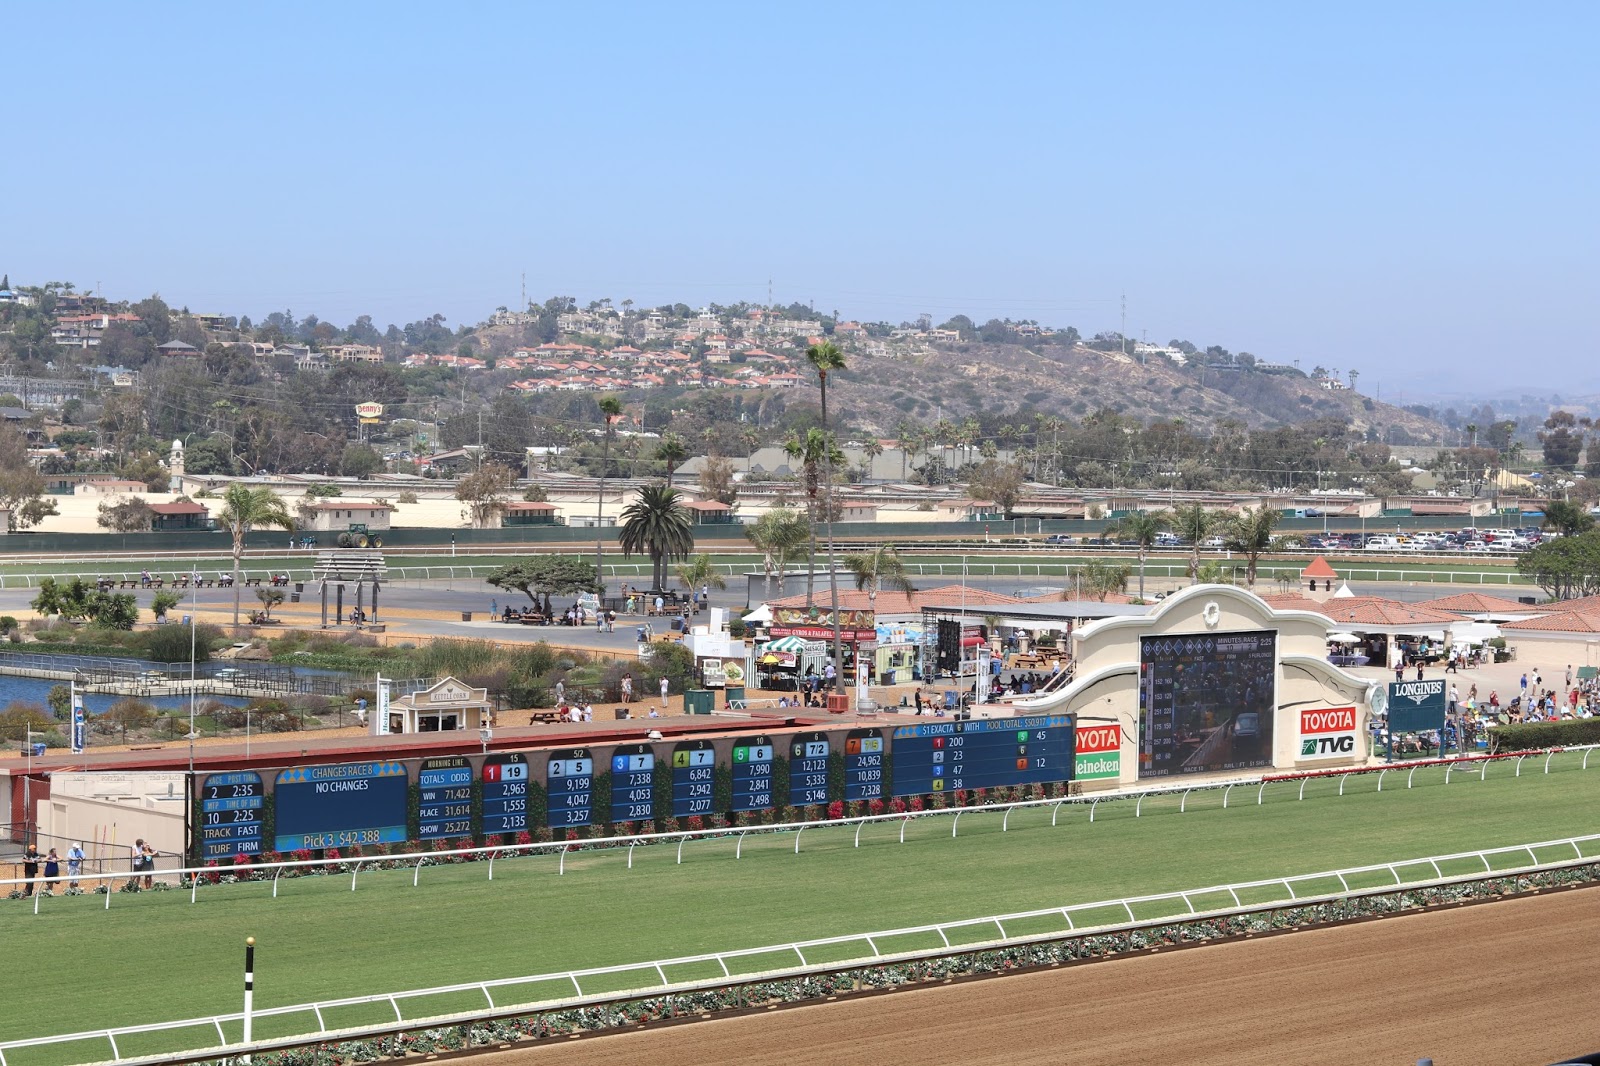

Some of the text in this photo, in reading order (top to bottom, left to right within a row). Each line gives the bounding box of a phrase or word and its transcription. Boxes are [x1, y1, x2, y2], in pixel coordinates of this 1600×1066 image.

[358, 405, 381, 413] Denny's
[1396, 682, 1442, 696] LONGINES
[922, 725, 930, 735] $1
[931, 724, 954, 734] EXACTA
[965, 722, 980, 731] WITH
[986, 721, 1002, 730] POOL
[1003, 719, 1022, 729] TOTAL:
[1024, 717, 1046, 728] $50,917
[1303, 711, 1353, 730] TOYOTA
[1036, 731, 1046, 740] 45
[850, 740, 856, 752] 7
[949, 737, 963, 747] 200
[1318, 736, 1353, 753] TVG
[573, 750, 583, 758] 5/2
[738, 749, 762, 761] 5 6
[795, 744, 824, 756] 6 7/2
[953, 751, 963, 761] 23
[428, 758, 464, 768] MORNING LINE
[510, 754, 518, 762] 15
[617, 758, 645, 769] 3 7
[678, 753, 705, 765] 4 7
[858, 755, 881, 767] 24,962
[1036, 758, 1046, 768] 12
[553, 762, 582, 775] 2 5
[750, 764, 770, 776] 7,990
[802, 759, 826, 772] 12,123
[953, 765, 963, 775] 47
[312, 765, 373, 779] CHANGES RACE 8
[420, 772, 470, 784] TOTALS ODDS
[488, 767, 520, 779] 1 19
[690, 768, 711, 781] 6,842
[858, 771, 881, 782] 10,839
[228, 774, 242, 784] POST
[242, 774, 256, 783] TIME
[566, 778, 589, 790] 9,199
[630, 773, 651, 786] 7,338
[749, 779, 769, 791] 2,841
[806, 775, 826, 786] 5,335
[953, 779, 963, 789] 38
[211, 784, 253, 798] 2 2:35
[316, 780, 368, 793] NO CHANGES
[503, 783, 526, 796] 2,965
[690, 784, 711, 796] 2,942
[861, 784, 880, 796] 7,328
[423, 788, 470, 800] WIN 71,422
[566, 794, 589, 806] 4,047
[629, 788, 650, 802] 4,053
[806, 790, 825, 802] 5,146
[207, 798, 260, 810] MTP TIME OF DAY
[503, 800, 525, 812] 1,555
[690, 800, 710, 812] 2,077
[749, 794, 769, 807] 2,498
[420, 804, 470, 817] PLACE 31,614
[566, 810, 589, 823] 3,257
[629, 805, 650, 817] 2,830
[208, 810, 254, 824] 10 2:25
[502, 816, 525, 828] 2,135
[204, 826, 259, 838] TRACK FAST
[420, 821, 470, 834] SHOW 25,272
[304, 830, 380, 848] Pick 3 $42,388
[209, 842, 258, 854] TURF FIRM
